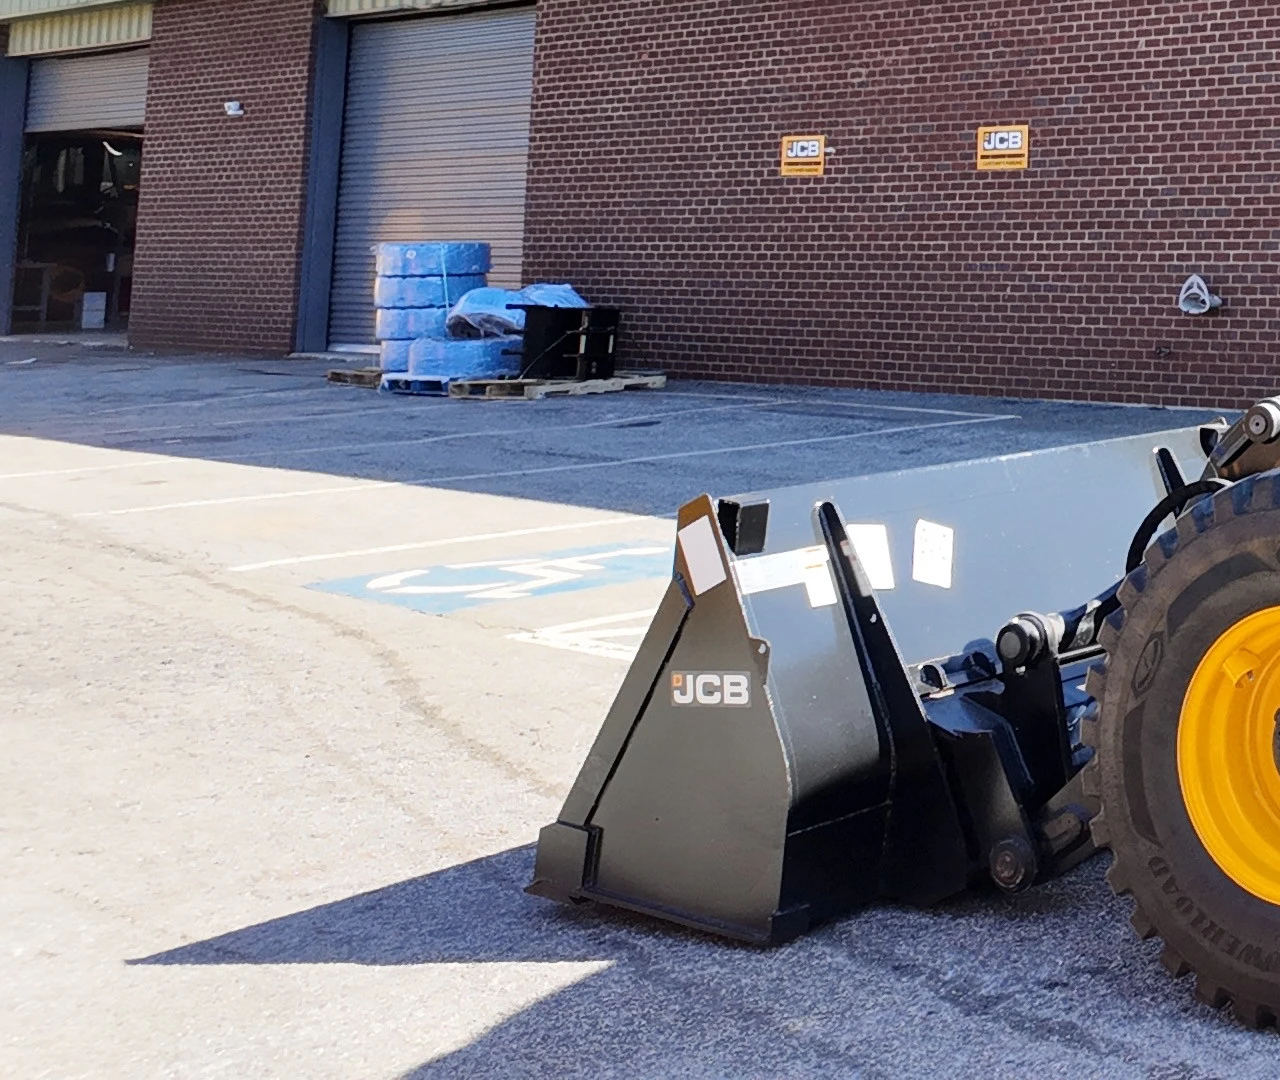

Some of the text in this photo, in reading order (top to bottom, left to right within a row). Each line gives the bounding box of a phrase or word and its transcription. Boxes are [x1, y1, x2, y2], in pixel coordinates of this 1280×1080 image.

[787, 140, 820, 157] JCB
[984, 131, 1022, 150] JCB
[673, 674, 749, 705] JCB
